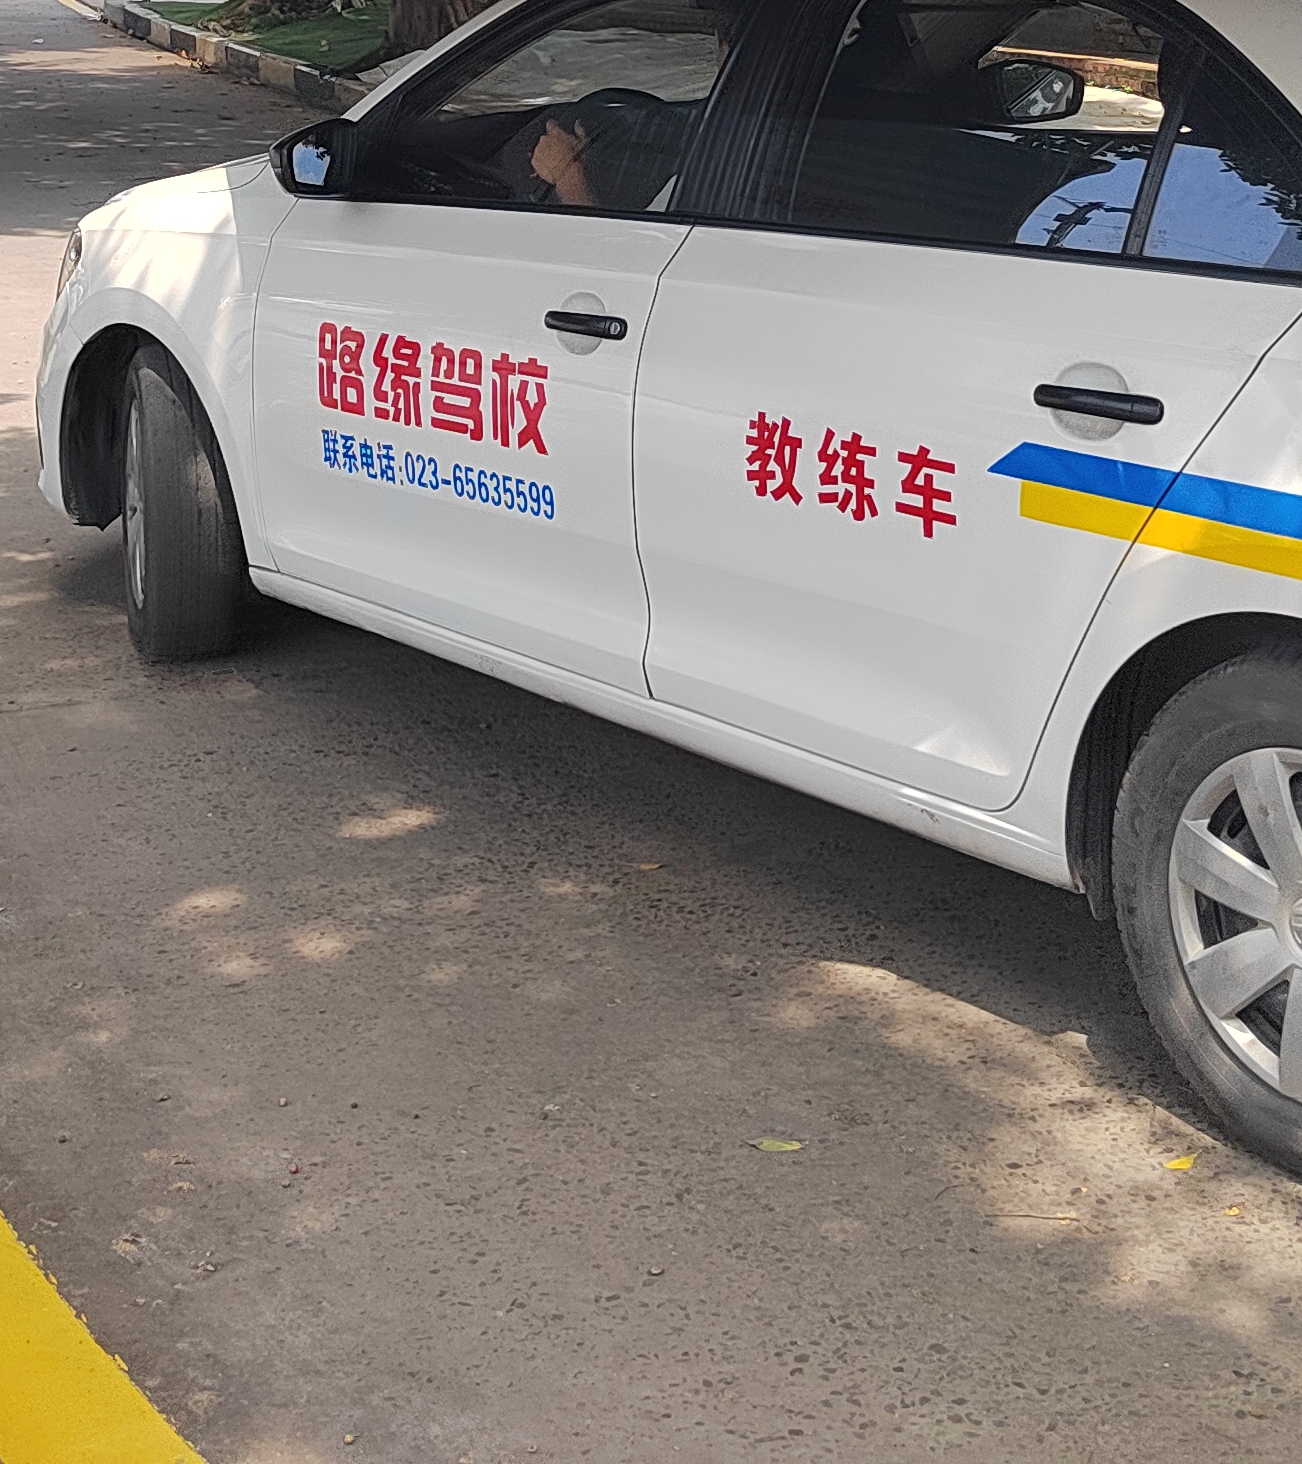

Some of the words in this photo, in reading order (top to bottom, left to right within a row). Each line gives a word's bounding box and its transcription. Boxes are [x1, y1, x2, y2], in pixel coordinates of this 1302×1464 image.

[318, 322, 549, 456] 路缘驾校
[320, 428, 556, 521] 联系电话:023-65635599
[745, 410, 958, 539] 教练车
